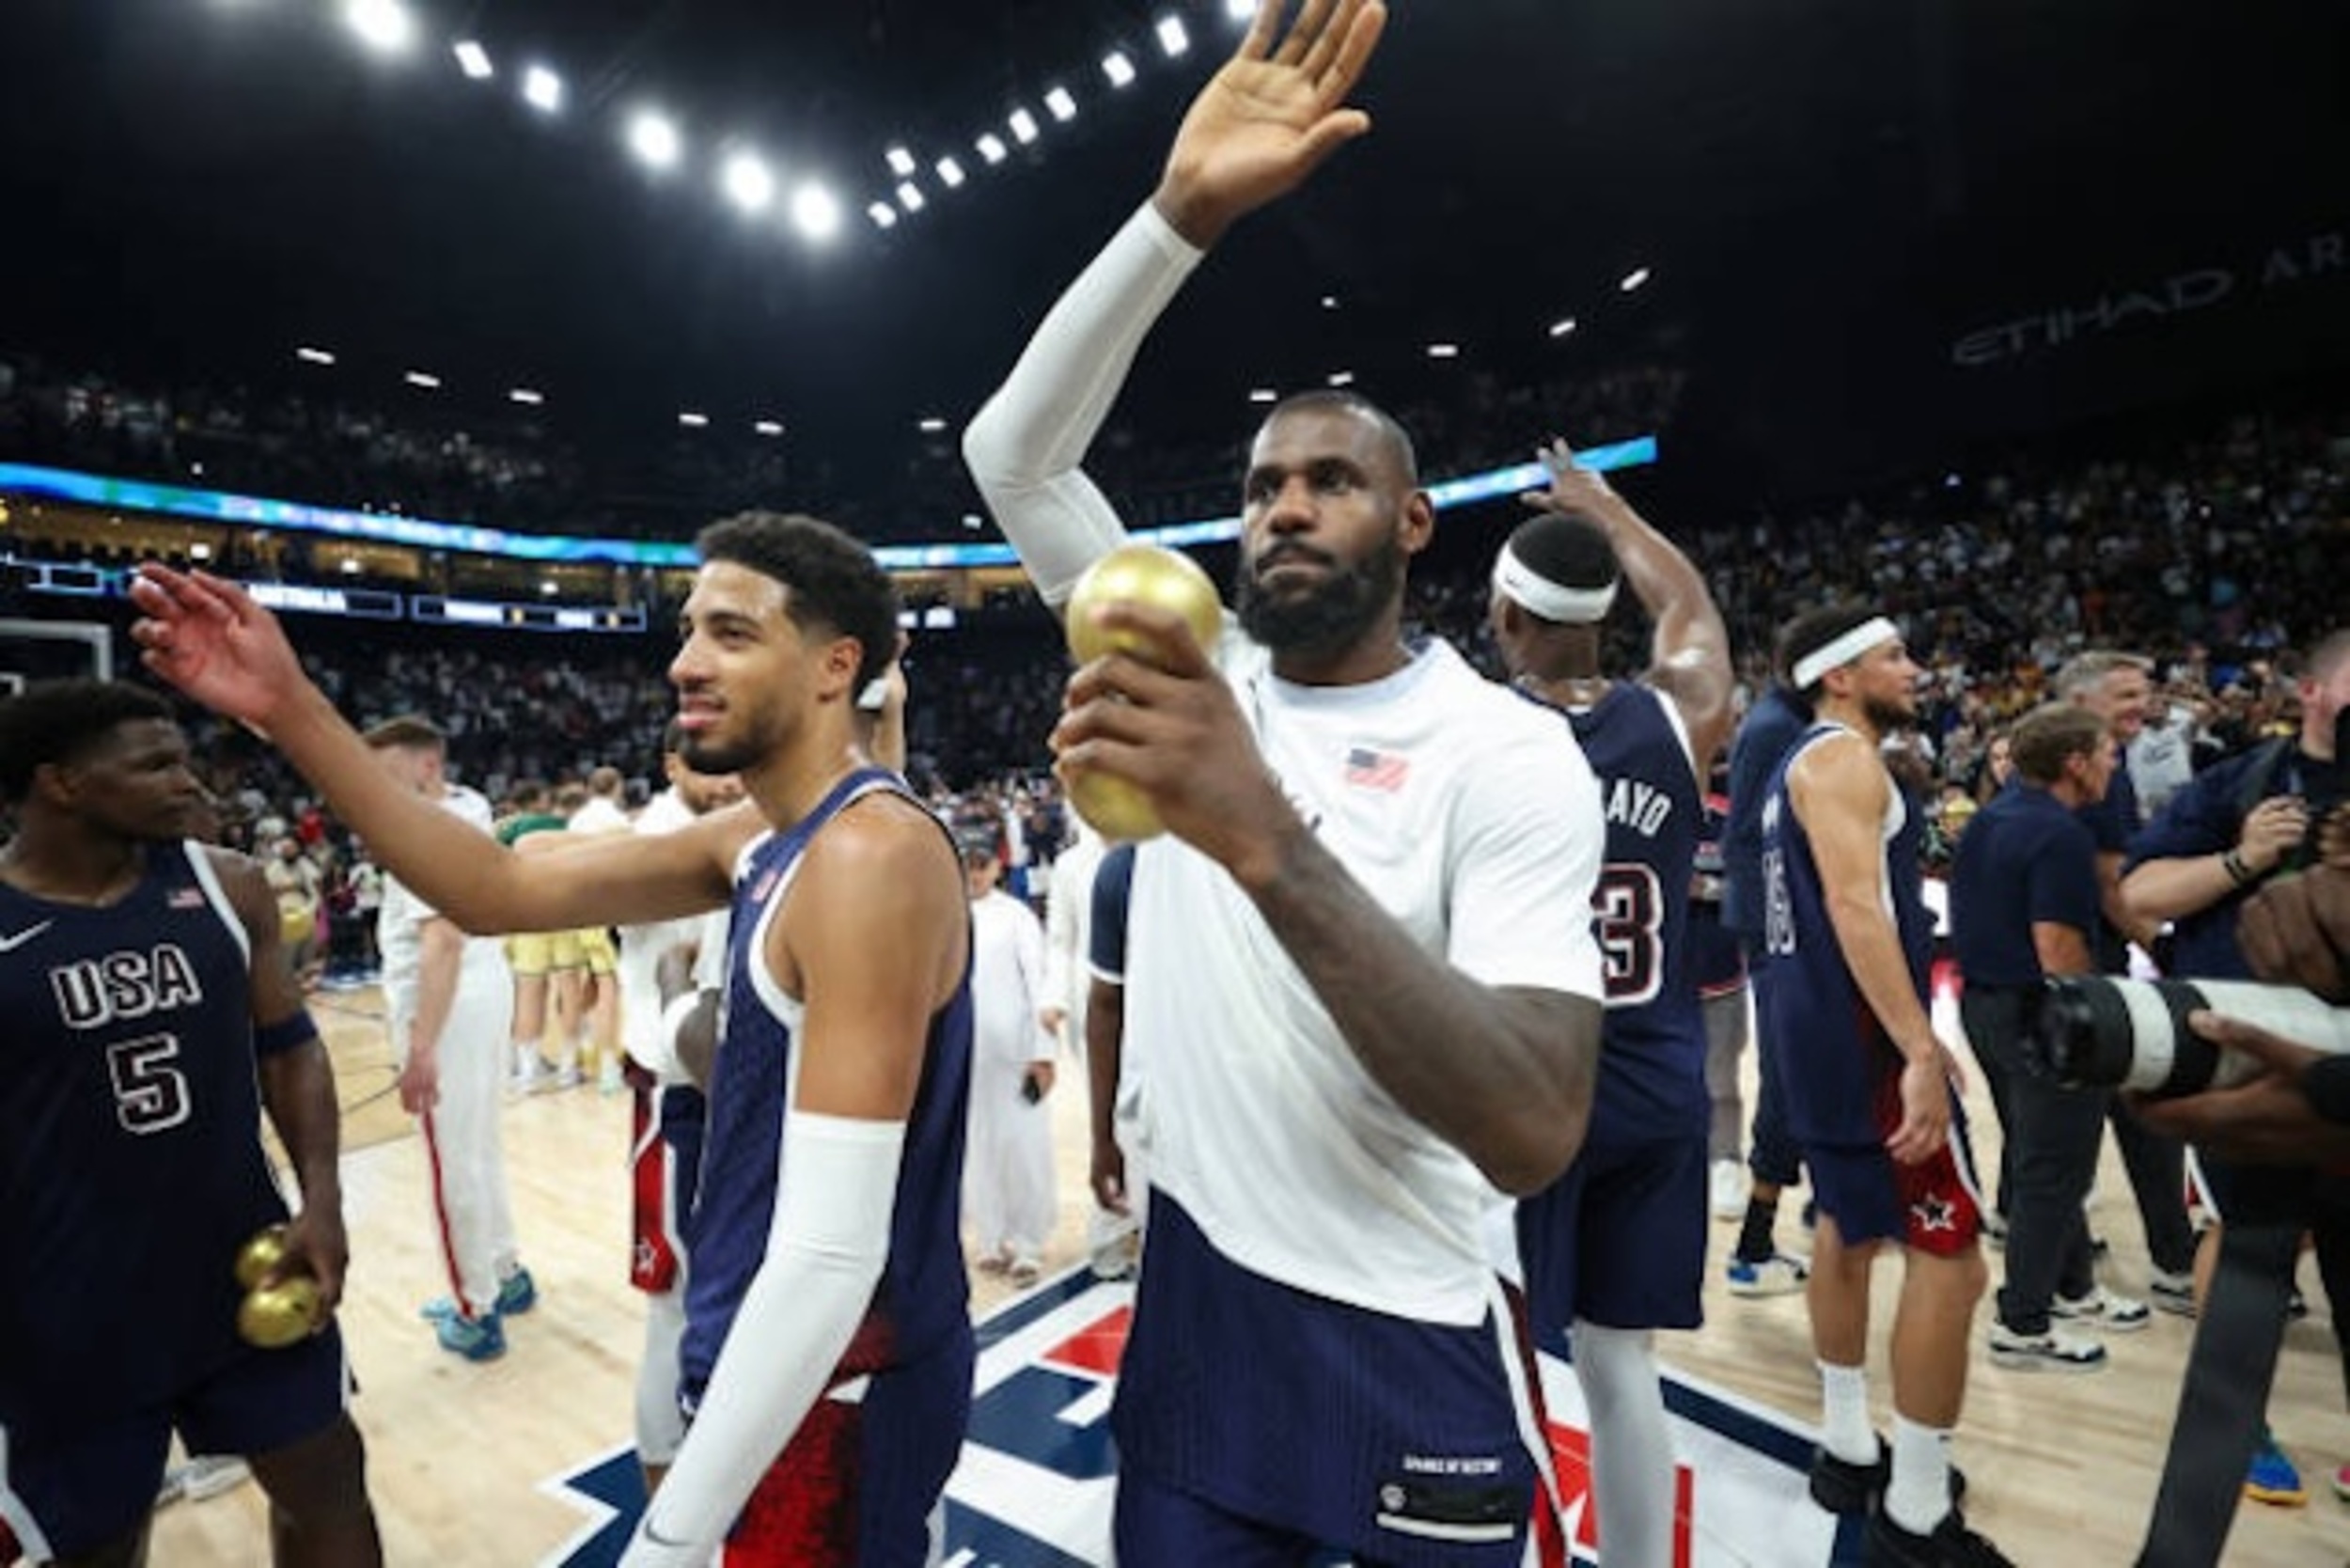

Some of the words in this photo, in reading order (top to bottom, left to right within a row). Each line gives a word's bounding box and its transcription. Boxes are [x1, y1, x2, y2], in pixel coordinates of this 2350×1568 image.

[1952, 267, 2233, 365] ETIHAD
[1607, 776, 1673, 838] AYO
[1590, 862, 1664, 1010] 3
[51, 943, 202, 1029] USA
[105, 1032, 193, 1136] 5
